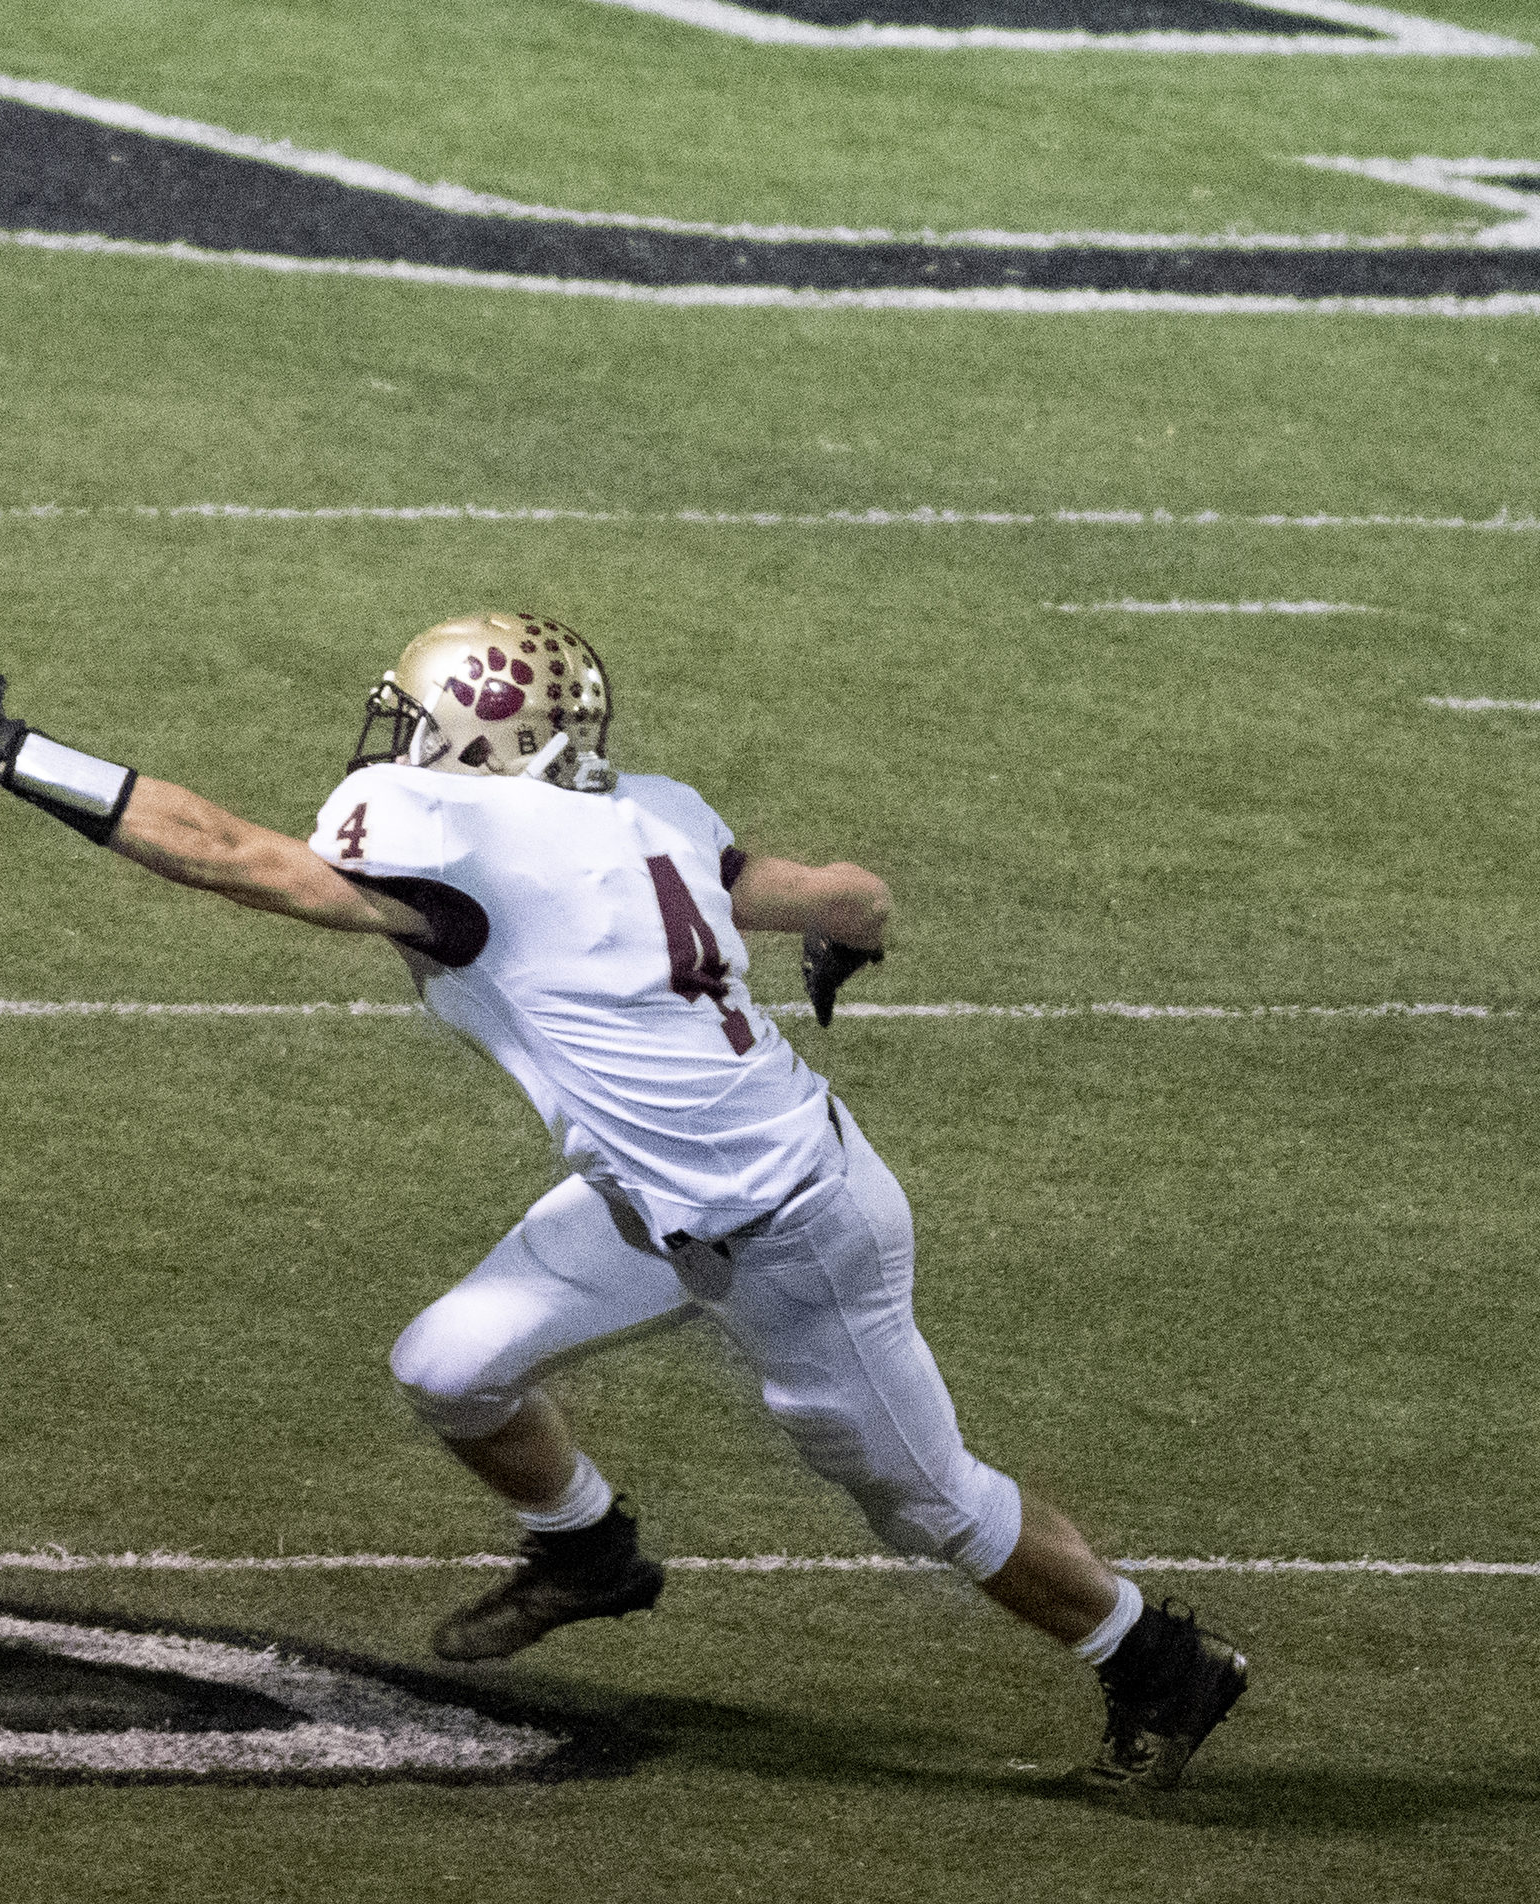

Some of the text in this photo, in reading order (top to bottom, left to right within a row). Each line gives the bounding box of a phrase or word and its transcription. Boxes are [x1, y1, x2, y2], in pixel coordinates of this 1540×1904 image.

[517, 729, 538, 755] B
[336, 803, 368, 859] 4
[646, 854, 755, 1056] 4
